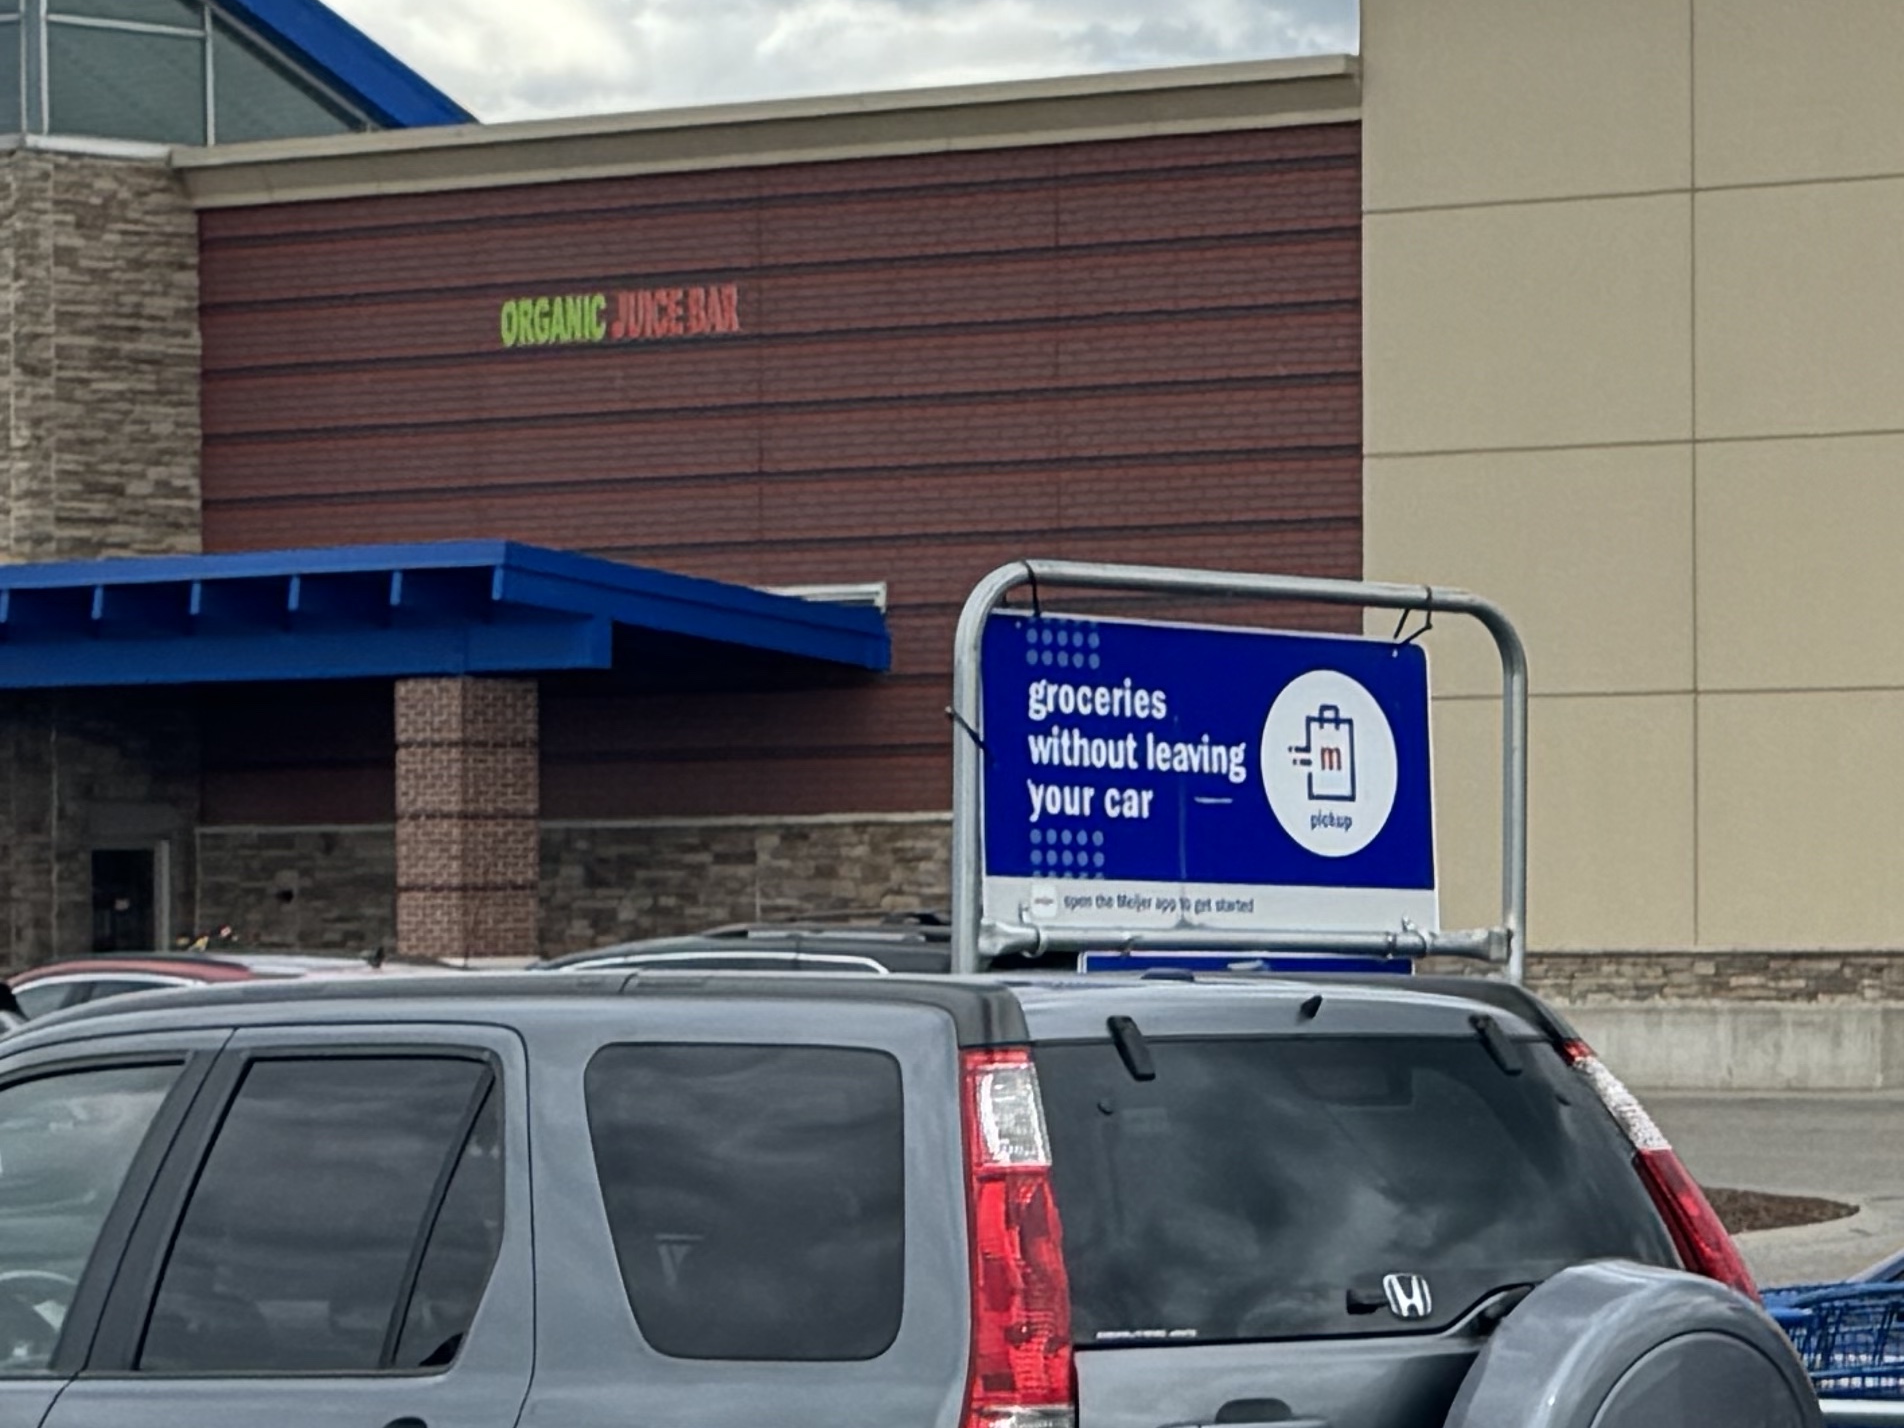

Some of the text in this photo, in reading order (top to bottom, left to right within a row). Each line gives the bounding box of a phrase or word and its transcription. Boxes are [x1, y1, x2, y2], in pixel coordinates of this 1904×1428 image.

[501, 283, 739, 347] ORGANIC JUICE BAR
[1028, 677, 1167, 721] groceries
[1028, 725, 1247, 784] without leaving
[1026, 778, 1153, 823] your car
[1310, 809, 1353, 832] pickup
